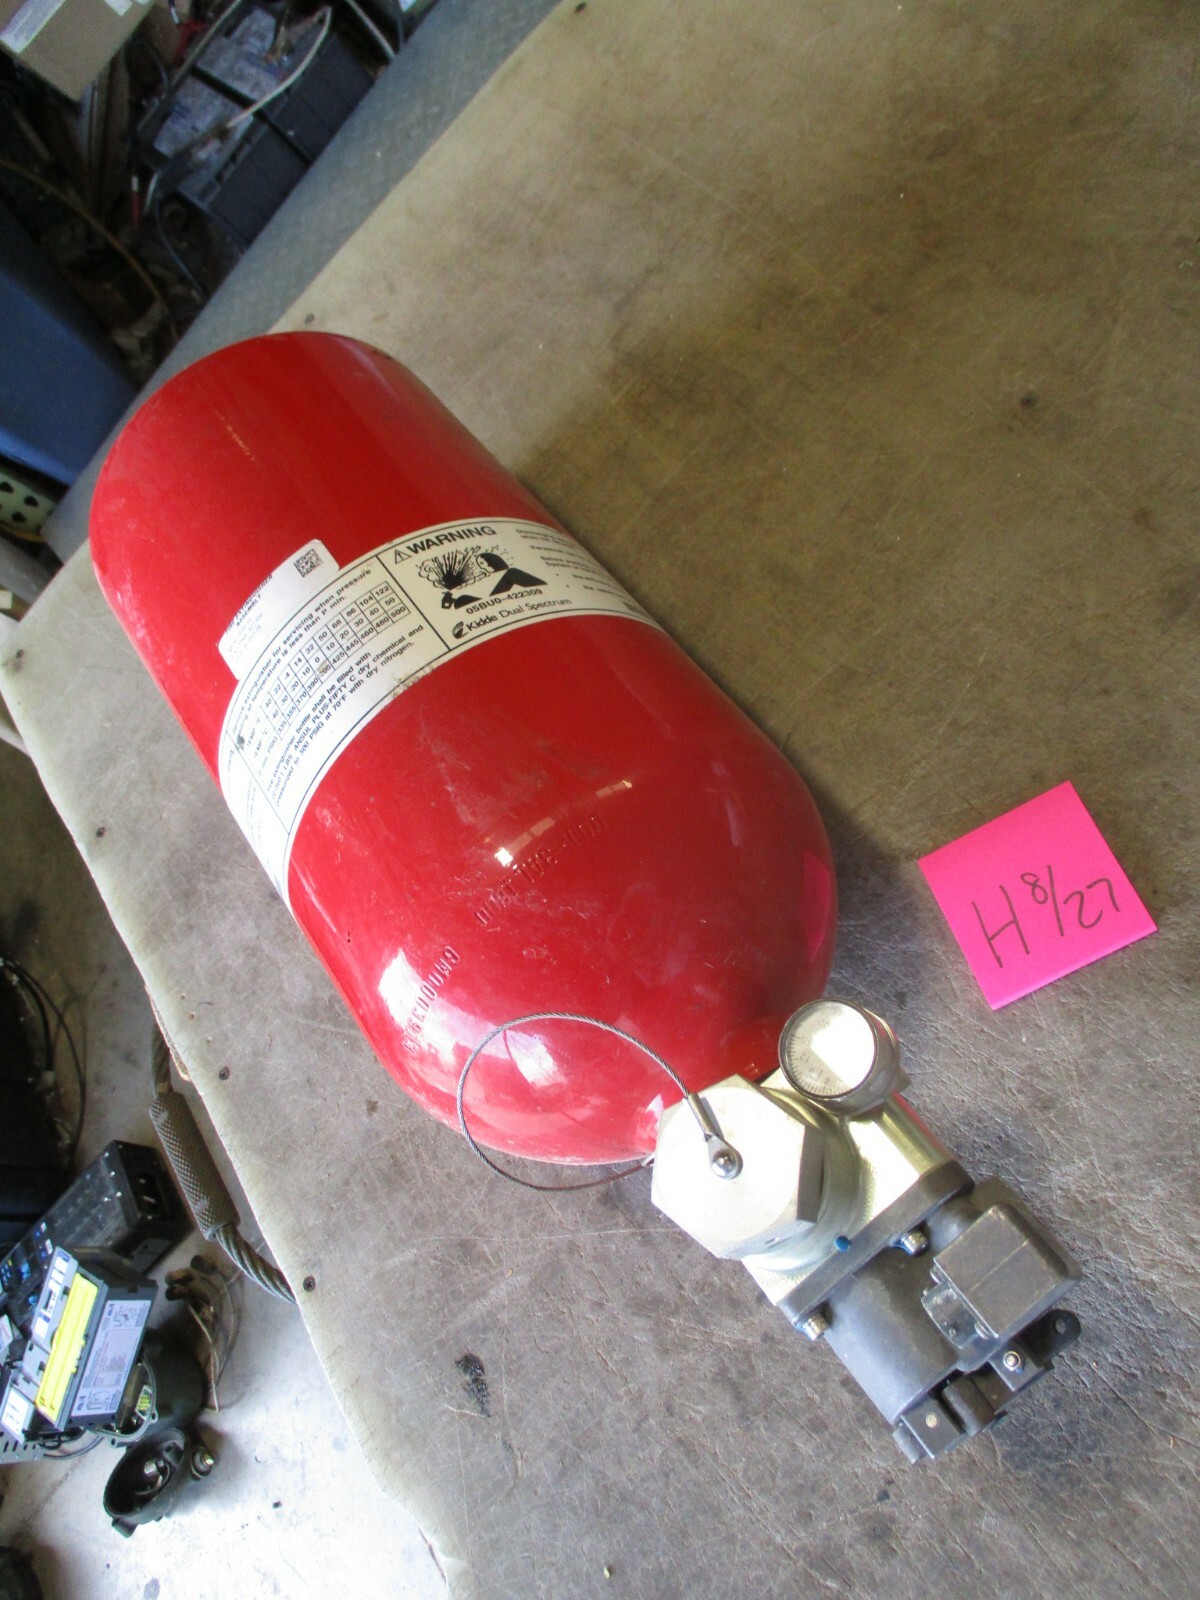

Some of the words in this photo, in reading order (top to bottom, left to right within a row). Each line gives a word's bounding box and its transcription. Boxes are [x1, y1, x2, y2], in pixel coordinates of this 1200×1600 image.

[406, 526, 498, 554] WARNING
[244, 658, 271, 704] extinguisher
[272, 646, 281, 657] for
[282, 613, 314, 645] servicing
[314, 595, 334, 612] when
[336, 569, 371, 596] pressure
[251, 658, 281, 702] temperature
[281, 649, 289, 657] is
[288, 632, 303, 649] less
[303, 616, 320, 632] than
[321, 608, 328, 616] P
[329, 596, 347, 609] min.
[294, 657, 303, 667] 14
[305, 644, 314, 654] 32
[318, 631, 328, 641] 50
[331, 619, 342, 629] 68
[346, 607, 357, 617] 86
[359, 595, 373, 607] 104
[375, 585, 389, 596] 122
[296, 691, 307, 705] 370
[307, 677, 319, 691] 390
[332, 651, 345, 664] 425
[345, 639, 359, 651] 445
[360, 627, 374, 640] 460
[375, 616, 390, 628] 480
[390, 606, 406, 618] 500
[326, 641, 336, 651] 10
[339, 630, 350, 639] 20
[354, 618, 364, 628] 30
[369, 607, 380, 617] 40
[384, 597, 396, 606] 50
[466, 615, 498, 630] Kidde
[498, 605, 525, 618] Dual
[524, 599, 573, 610] Spectrum
[273, 735, 295, 778] extinguisher
[295, 713, 311, 734] bottle
[311, 693, 326, 712] shall
[326, 684, 336, 694] be
[336, 665, 354, 684] filled
[354, 652, 371, 666] with
[283, 753, 293, 770] LBS
[293, 726, 312, 750] ANSUL
[311, 682, 348, 724] PLUS-FIFTY
[349, 674, 356, 682] C
[357, 662, 370, 675] dry
[372, 635, 406, 663] chemical
[408, 624, 424, 638] and
[300, 740, 310, 755] 500
[309, 721, 324, 741] PSIG
[325, 711, 332, 721] at
[348, 678, 365, 694] with
[365, 666, 379, 679] dry
[380, 642, 415, 667] nitrogen.
[971, 884, 1030, 968] H
[1020, 865, 1120, 936] 8/27
